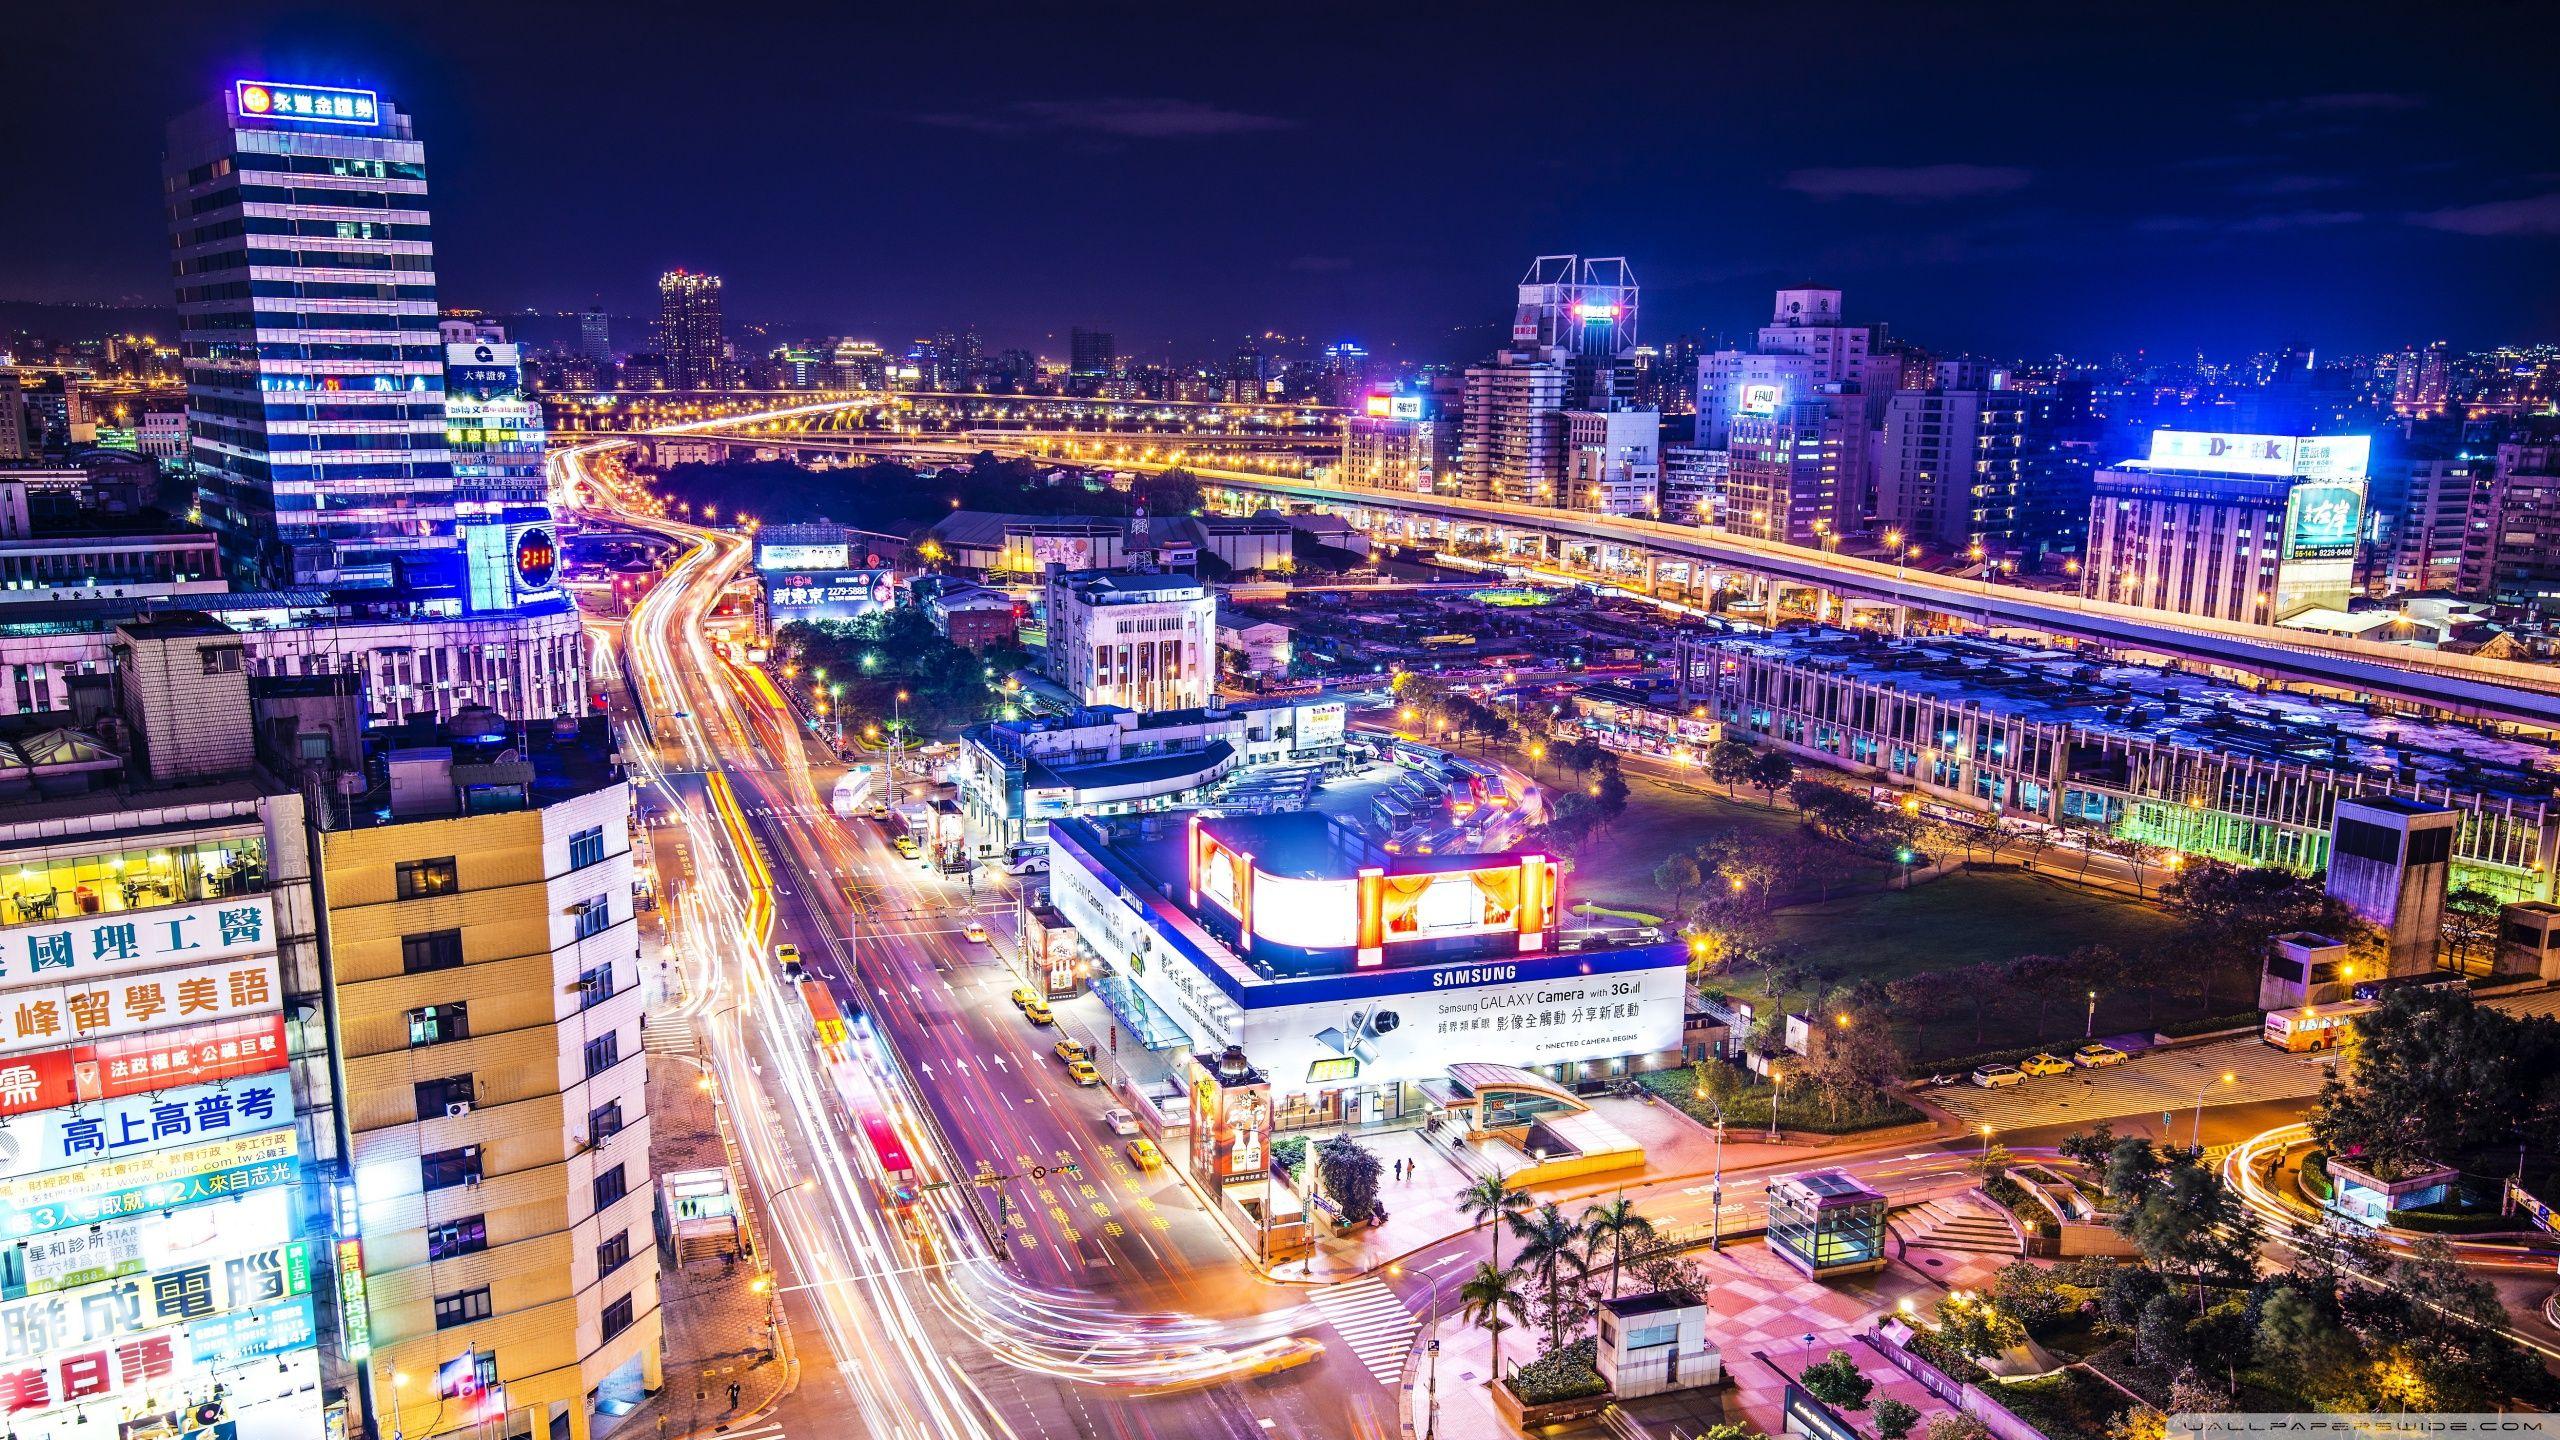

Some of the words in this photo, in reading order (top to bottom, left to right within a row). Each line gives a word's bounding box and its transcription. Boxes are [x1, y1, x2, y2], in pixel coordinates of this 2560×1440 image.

[464, 371, 507, 381] 大華證券
[522, 550, 552, 569] 2:11
[773, 587, 825, 605] 新東京
[1433, 966, 1516, 987] SAMSUNG
[0, 967, 269, 1043] 峰留學美語
[1438, 1002, 1478, 1015] Samsung
[1481, 993, 1534, 1011] GALAXY
[1537, 987, 1585, 1004] Camera
[1589, 988, 1608, 998] with
[1611, 983, 1630, 996] 3G
[1497, 1011, 1566, 1031] 影像全觸動
[1571, 1002, 1640, 1024] 分享新感動
[1536, 1039, 1579, 1051] CNNECTED
[1581, 1036, 1611, 1046] CAMERA
[1612, 1033, 1638, 1043] BEGINS
[61, 1087, 276, 1156] 高上高普考
[9, 1162, 291, 1233] 3人取就2人來自志光
[29, 1232, 104, 1262] 星和診所
[106, 1226, 138, 1241] STAR
[2, 1249, 284, 1355] 聯成電腦
[0, 1334, 174, 1415] 美日語
